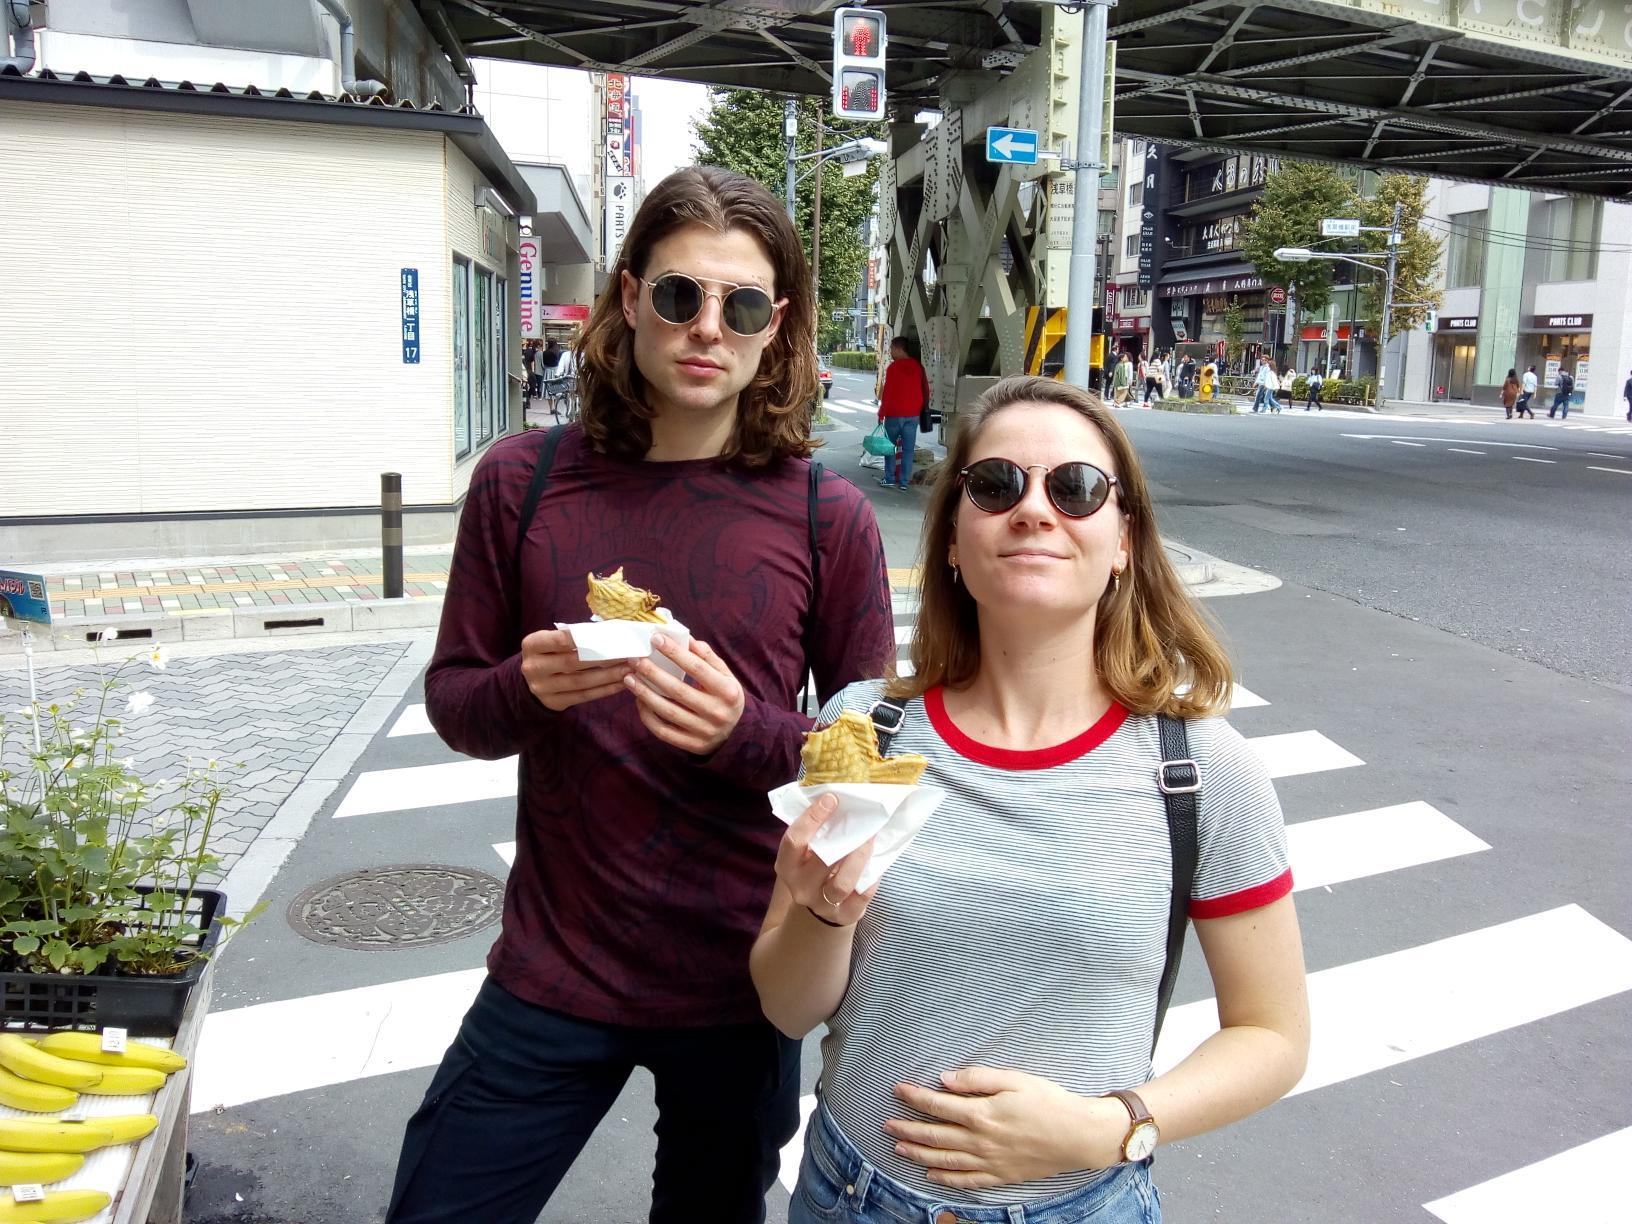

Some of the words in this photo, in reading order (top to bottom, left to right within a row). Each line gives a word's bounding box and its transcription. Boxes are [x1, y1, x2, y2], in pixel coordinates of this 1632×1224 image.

[1146, 144, 1158, 188] 久月
[615, 205, 625, 239] PARTS
[520, 242, 538, 332] Genuine
[1450, 319, 1465, 327] PARTS
[1465, 319, 1477, 327] CLUB
[1549, 317, 1566, 326] PARTS
[1567, 317, 1582, 326] CLUB
[405, 347, 417, 359] 17
